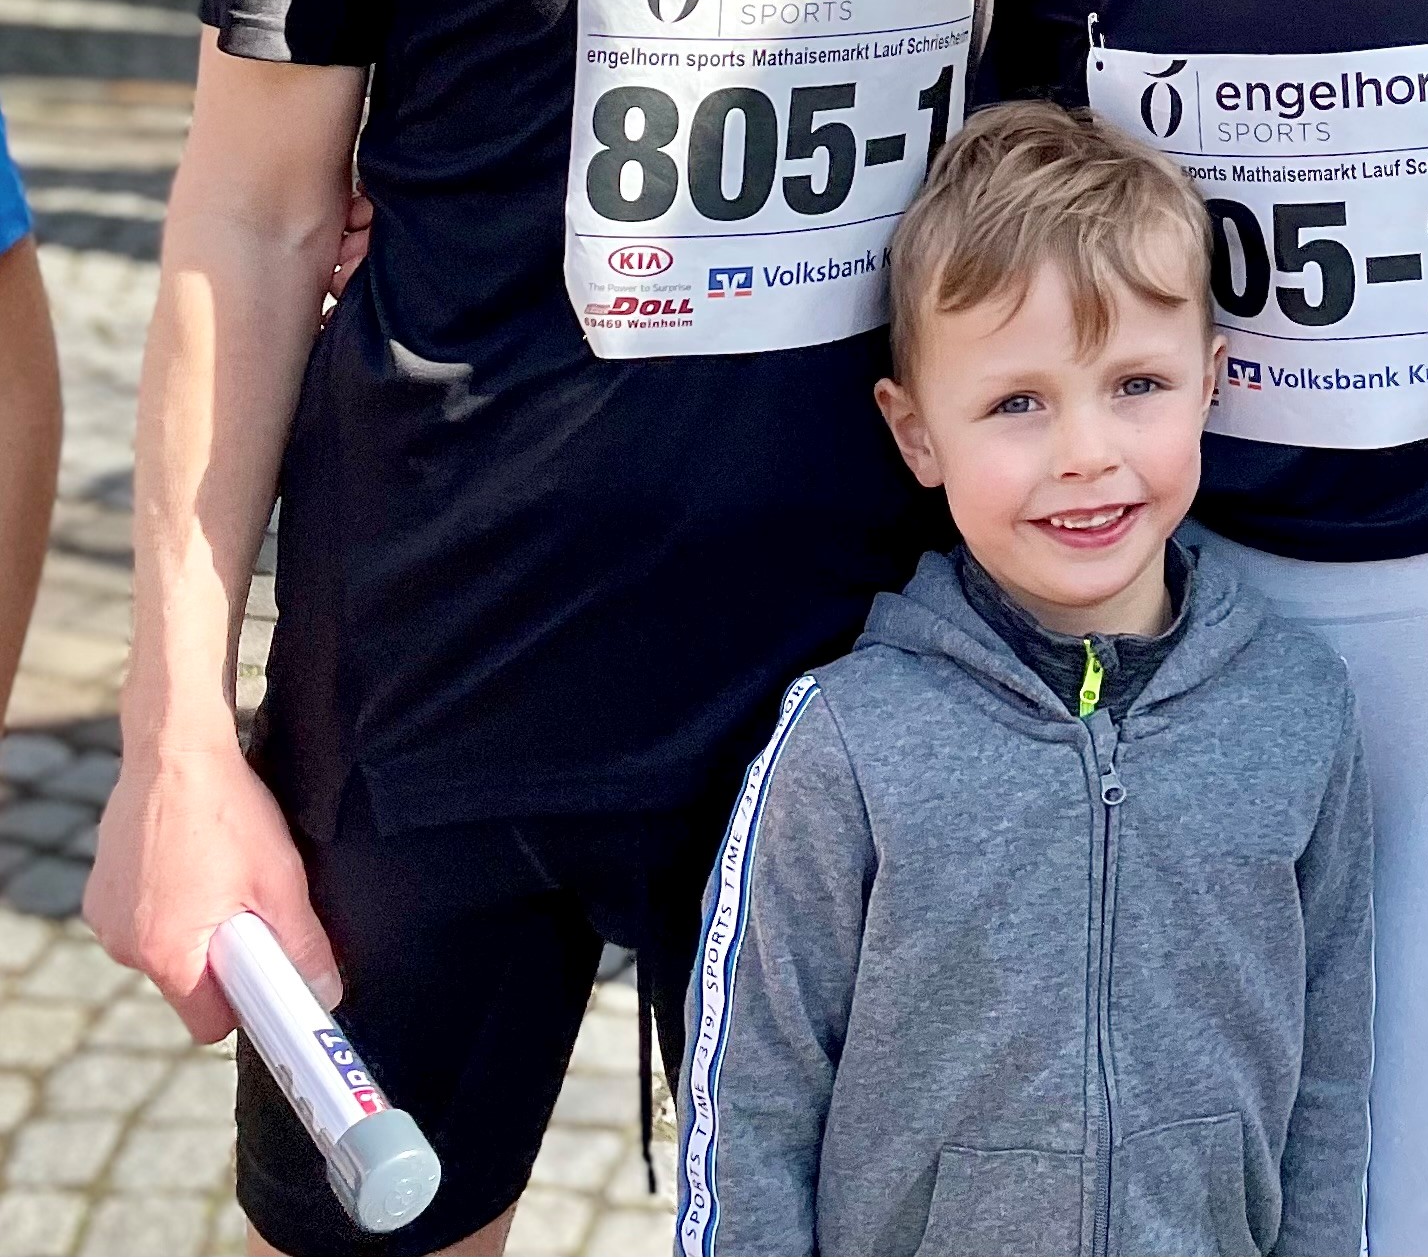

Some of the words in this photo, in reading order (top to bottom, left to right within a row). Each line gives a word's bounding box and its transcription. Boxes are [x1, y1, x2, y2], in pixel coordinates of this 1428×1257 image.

[740, 0, 853, 26] SPORTS
[587, 47, 680, 69] engelhorn
[686, 50, 746, 71] sports
[751, 44, 870, 68] Mathaisemarkt
[873, 38, 905, 59] Lauf
[586, 64, 954, 223] 805-1
[1217, 121, 1331, 144] SPORTS
[1232, 163, 1357, 183] Mathaisemarkt
[1362, 159, 1401, 179] Lauf
[619, 252, 662, 270] KIA
[763, 249, 877, 289] Volksbank
[652, 282, 692, 294] Surprise
[608, 296, 694, 316] DOLL
[627, 318, 693, 329] Weinheim
[1267, 364, 1400, 393] Volksbank
[724, 833, 743, 890] TIME
[706, 903, 732, 993] SPORTS
[694, 1084, 710, 1137] TIME
[686, 1153, 706, 1241] SPORTS
